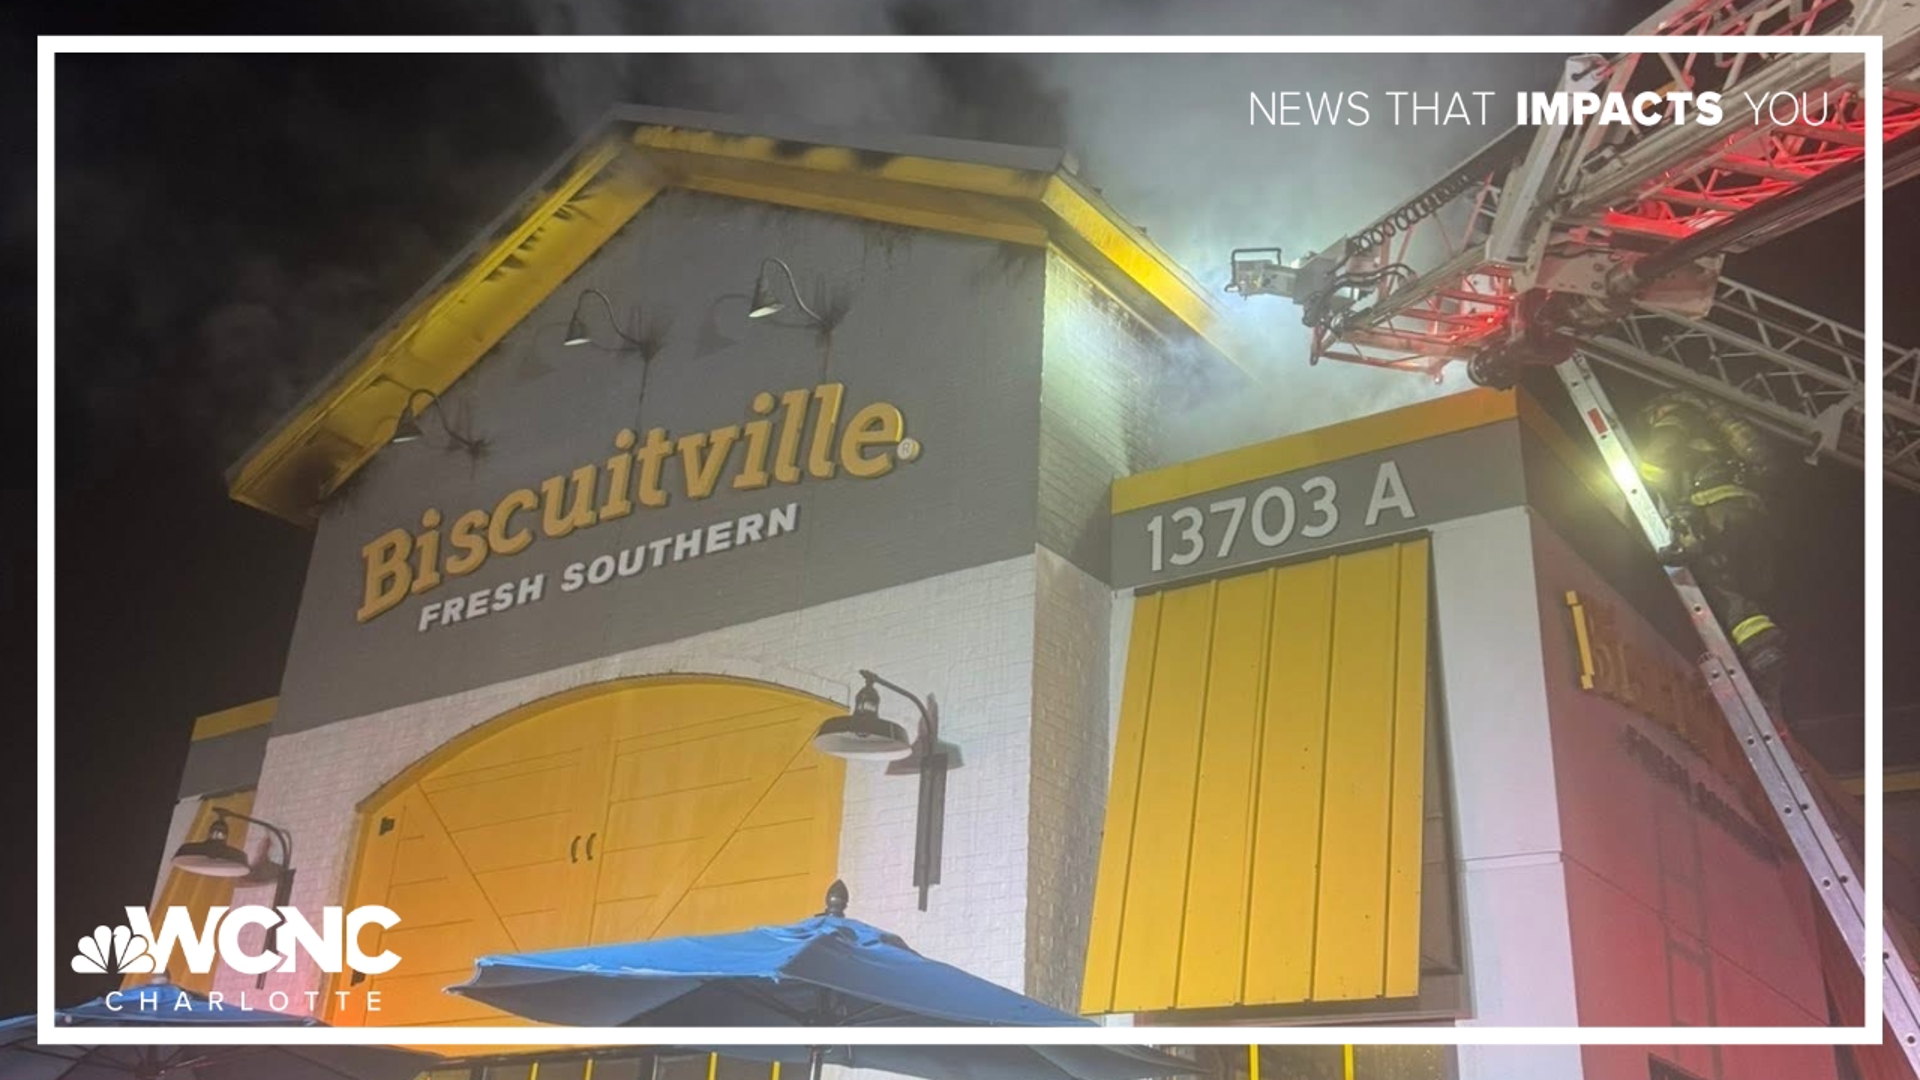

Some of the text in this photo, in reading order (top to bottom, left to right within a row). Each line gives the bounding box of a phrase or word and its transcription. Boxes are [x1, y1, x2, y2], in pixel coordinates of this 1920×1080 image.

[418, 502, 799, 632] FRESH SOUTHERN
[1147, 460, 1416, 572] 13703 A
